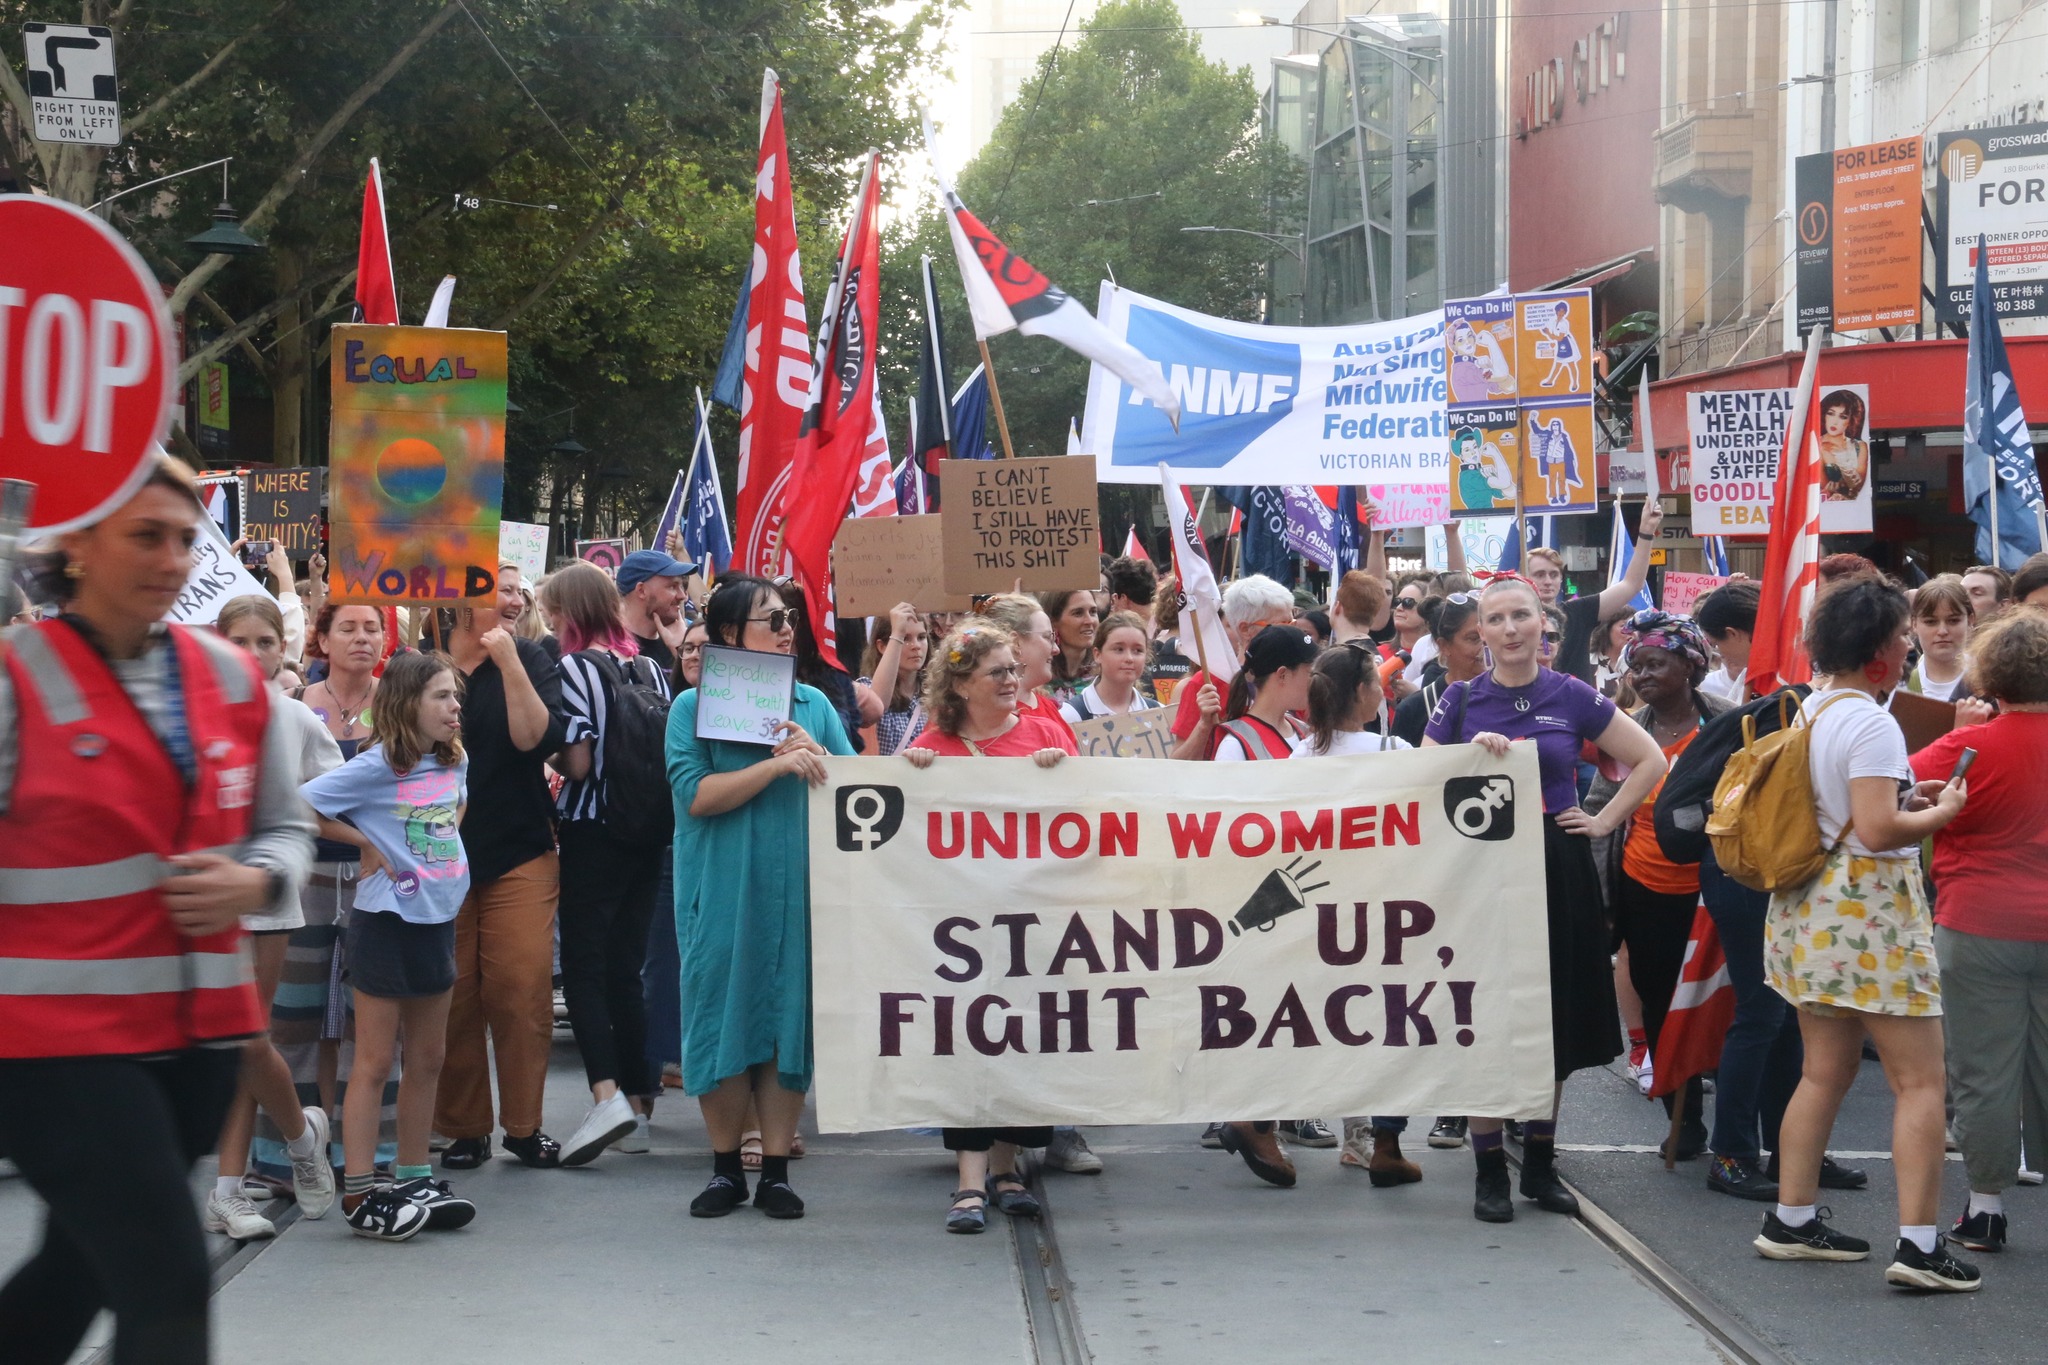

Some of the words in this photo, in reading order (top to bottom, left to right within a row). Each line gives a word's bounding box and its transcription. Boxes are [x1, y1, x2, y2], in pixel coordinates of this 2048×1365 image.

[35, 102, 73, 114] RIGHT
[80, 104, 115, 116] TURN
[39, 115, 73, 126] FROM
[83, 117, 114, 128] LEFT
[60, 128, 94, 139] ONLY
[1988, 130, 2048, 152] grosswad
[1836, 151, 1866, 171] FOR
[1871, 141, 1916, 165] LEASE
[1837, 176, 1854, 184] LEVEL
[1870, 169, 1892, 179] BOURKE
[1893, 164, 1915, 174] STREET
[2003, 165, 2017, 174] 180
[2018, 163, 2046, 172] Bourke
[1979, 178, 2046, 208] FOR
[463, 198, 479, 209] 48
[1955, 235, 1978, 245] BEST
[1985, 232, 2019, 242] ORNER
[2021, 229, 2048, 239] OPPO
[1986, 247, 2014, 256] IRTEEN
[2030, 244, 2048, 253] BOUT
[1988, 255, 2021, 264] OFFERED
[2023, 252, 2048, 261] SEPARA
[1950, 290, 1973, 302] GLE
[2013, 299, 2036, 310] 388
[1446, 305, 1459, 317] We
[1464, 304, 1483, 316] Can
[1485, 302, 1498, 313] Do
[1501, 300, 1513, 312] It!
[1333, 321, 1444, 358] Austral
[0, 285, 153, 454] TOP
[1325, 376, 1447, 407] Midwife
[1700, 391, 1793, 414] MENTAL
[1323, 410, 1448, 440] Federati
[1450, 414, 1464, 425] We
[1467, 413, 1486, 423] Can
[1488, 411, 1502, 422] Do
[1505, 410, 1516, 421] It!
[1696, 432, 1784, 449] UNDERPAI
[1320, 453, 1412, 469] VICTORIAN
[1419, 453, 1449, 469] BRA
[1717, 450, 1778, 465] &UNDE
[977, 471, 986, 486] I
[995, 467, 1050, 487] CAN'T
[1710, 464, 1776, 480] STAFFE
[255, 472, 311, 493] WHERE
[1694, 482, 1775, 502] GOODL
[1877, 483, 1906, 493] ussell
[1909, 482, 1921, 493] St
[972, 487, 1053, 507] BELIEVE
[273, 500, 289, 517] IS
[1372, 501, 1433, 525] killing
[973, 513, 982, 530] I
[990, 511, 1037, 528] STILL
[1046, 508, 1091, 527] HAVE
[979, 531, 1002, 548] TO
[1010, 527, 1094, 547] PROTEST
[1662, 527, 1693, 538] STA
[973, 551, 1015, 569] THIS
[1023, 549, 1069, 568] SHIT
[338, 544, 495, 599] WORLD
[1665, 573, 1690, 584] How
[1696, 576, 1717, 586] can
[1664, 586, 1678, 598] my
[746, 690, 785, 712] Health
[706, 707, 755, 733] Leave
[926, 811, 1138, 860] UNION
[1167, 801, 1420, 859] WOMEN
[934, 907, 1224, 983] STAND
[1316, 900, 1454, 970] UP,
[879, 987, 1151, 1057] FIGHT
[1198, 980, 1476, 1049] BACK!
